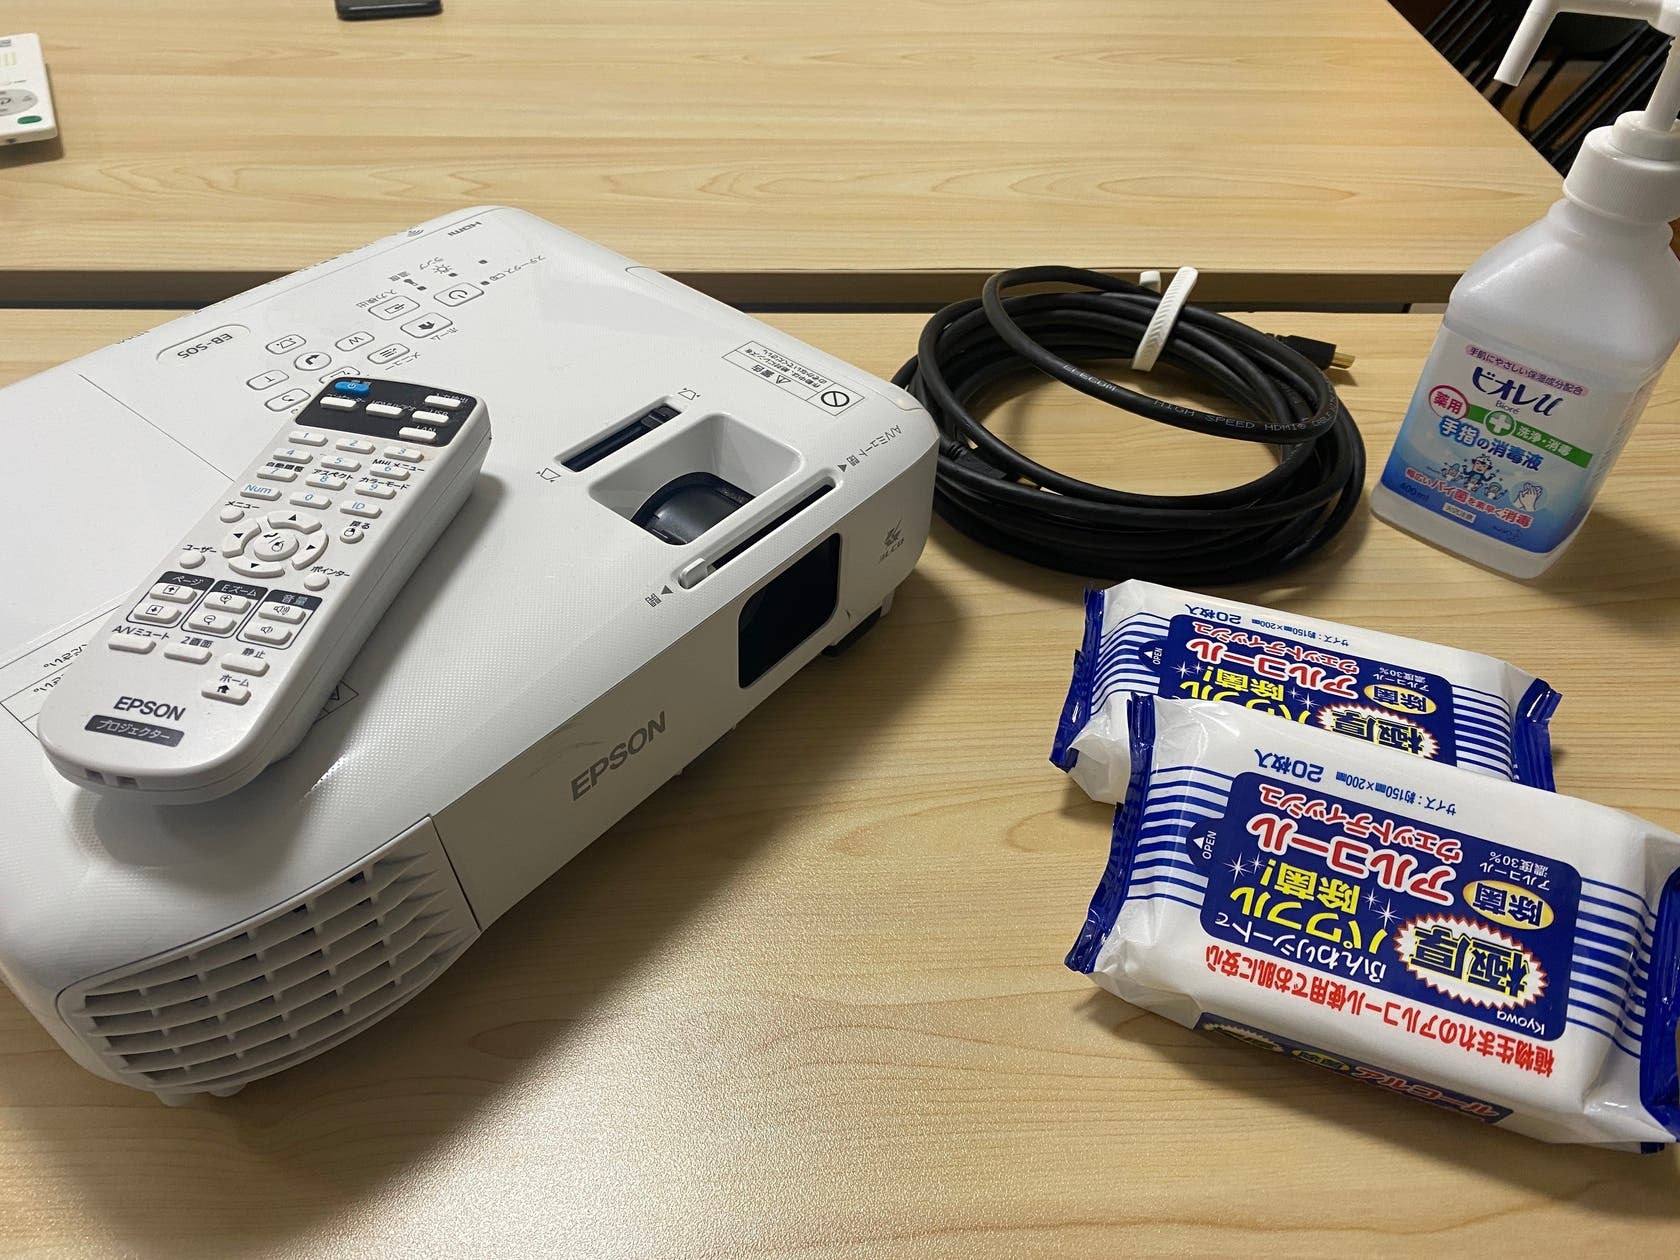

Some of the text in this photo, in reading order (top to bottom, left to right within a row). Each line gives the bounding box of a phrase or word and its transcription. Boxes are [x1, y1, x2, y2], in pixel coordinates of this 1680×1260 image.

[177, 333, 233, 359] EB-S05
[1152, 399, 1195, 417] HIGH
[1204, 414, 1256, 431] SPEED
[1433, 391, 1463, 415] 薬用
[1439, 416, 1545, 472] 手指の消毒液
[245, 484, 272, 494] Num
[225, 500, 260, 510] メニュー
[351, 502, 366, 510] ID
[182, 544, 217, 554] ユーザー
[172, 575, 204, 586] ページ
[310, 565, 351, 577] ポインター
[1185, 604, 1242, 625] 20枚入
[1153, 647, 1163, 665] OPEN
[1193, 622, 1359, 675] ウェットティッシュ
[219, 674, 250, 687] ホーム
[1187, 639, 1359, 699] アルコール
[1373, 673, 1430, 692] アルコール
[1203, 666, 1284, 701] 除菌!
[113, 695, 186, 721] EPSON
[1373, 686, 1427, 712] 除菌
[96, 719, 170, 740] プロジェクター
[571, 711, 667, 801] EPSON
[1254, 748, 1324, 784] 20枚入
[1259, 783, 1463, 863] ウェットティッシュ
[1202, 831, 1217, 860] OPEN
[1247, 813, 1456, 906] アルコール
[1480, 862, 1550, 891] アルコール
[1489, 851, 1549, 877] 濃度30%
[1260, 858, 1361, 915] 除菌!
[1473, 882, 1543, 927] 除菌
[1229, 886, 1389, 955] パワフル
[1215, 912, 1387, 983] ふんわりシートで
[1409, 925, 1530, 997] 極厚
[1205, 944, 1555, 1078] 植物生まれのアルコール使用でお肌に安心
[1496, 1009, 1545, 1036] Kyowa
